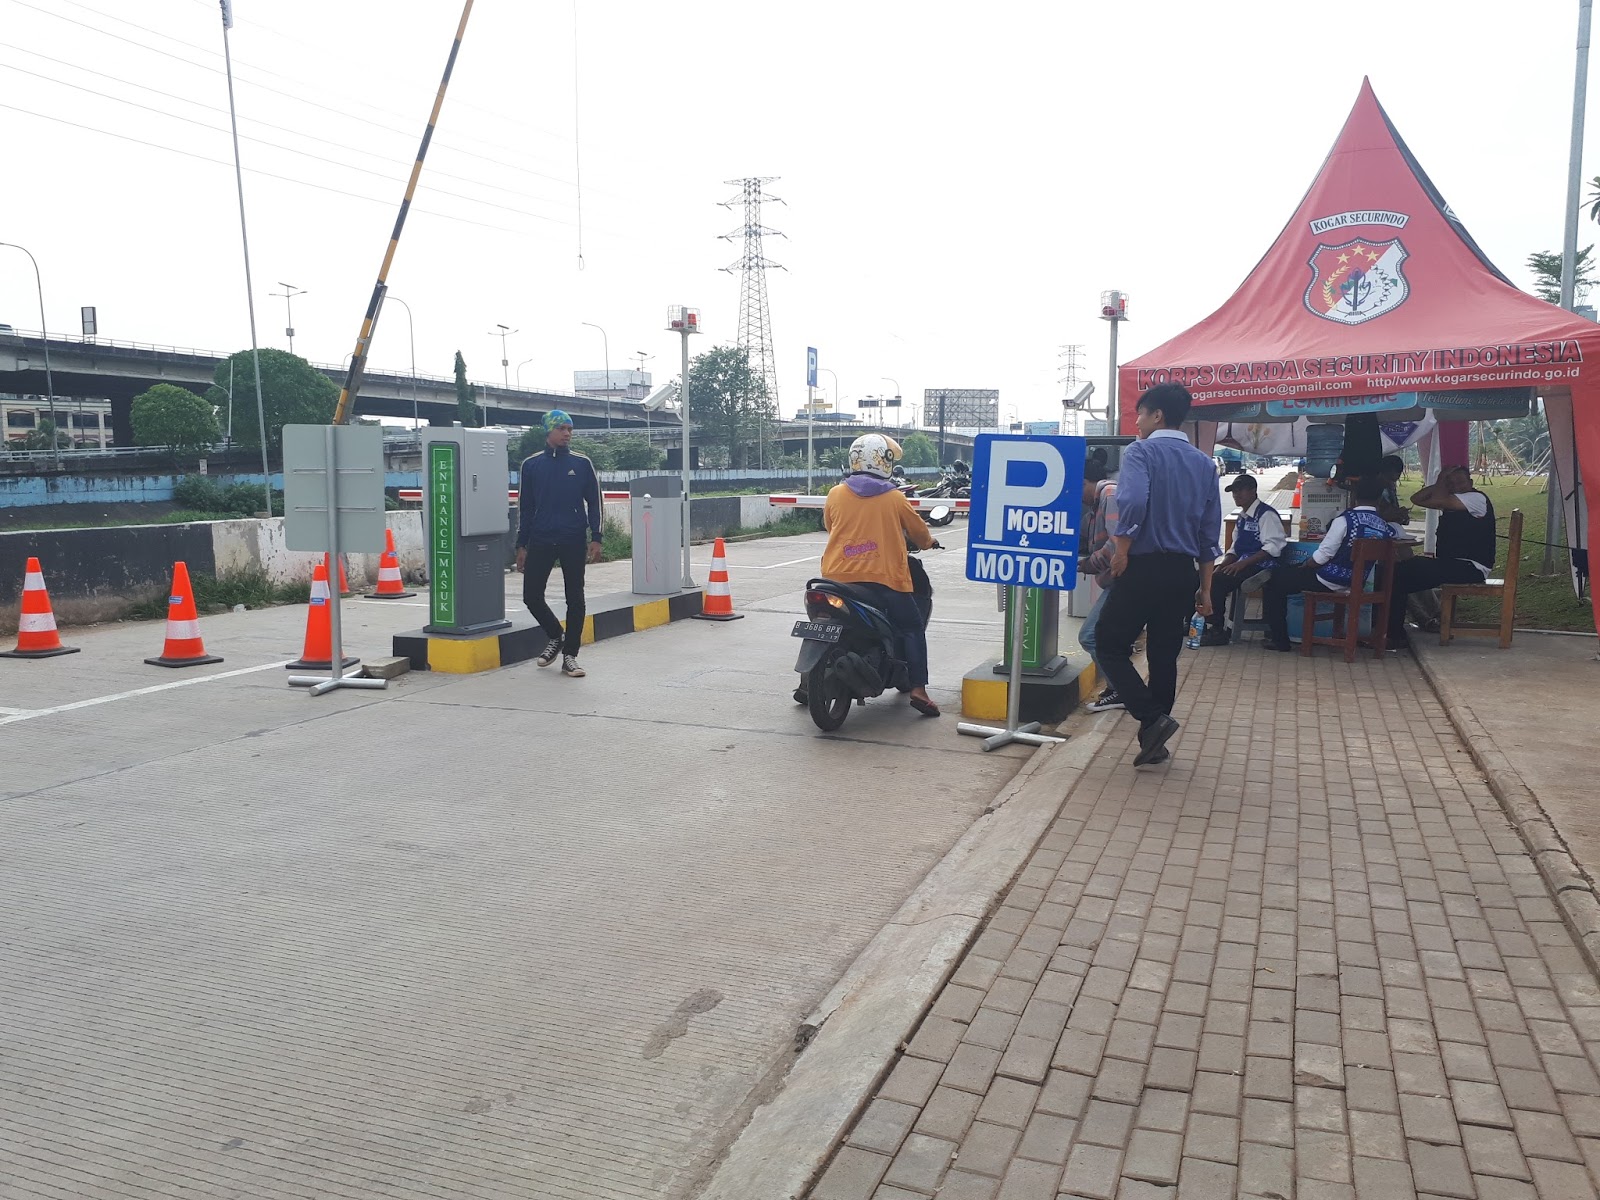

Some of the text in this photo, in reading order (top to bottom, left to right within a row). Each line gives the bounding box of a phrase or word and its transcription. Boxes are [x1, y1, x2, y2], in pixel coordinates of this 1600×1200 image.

[1313, 212, 1406, 232] KOGAR SECURINDO
[1138, 340, 1583, 392] KORPS GARDA SECURITY INDONESIA
[1190, 379, 1352, 401] ogarsecurindo@gmail.com
[439, 460, 449, 549] ENTRANCE
[984, 440, 1066, 542] P
[1007, 508, 1075, 535] MOBIL
[1019, 534, 1030, 547] &
[439, 558, 449, 612] MASUK
[975, 552, 1065, 587] MOTOR
